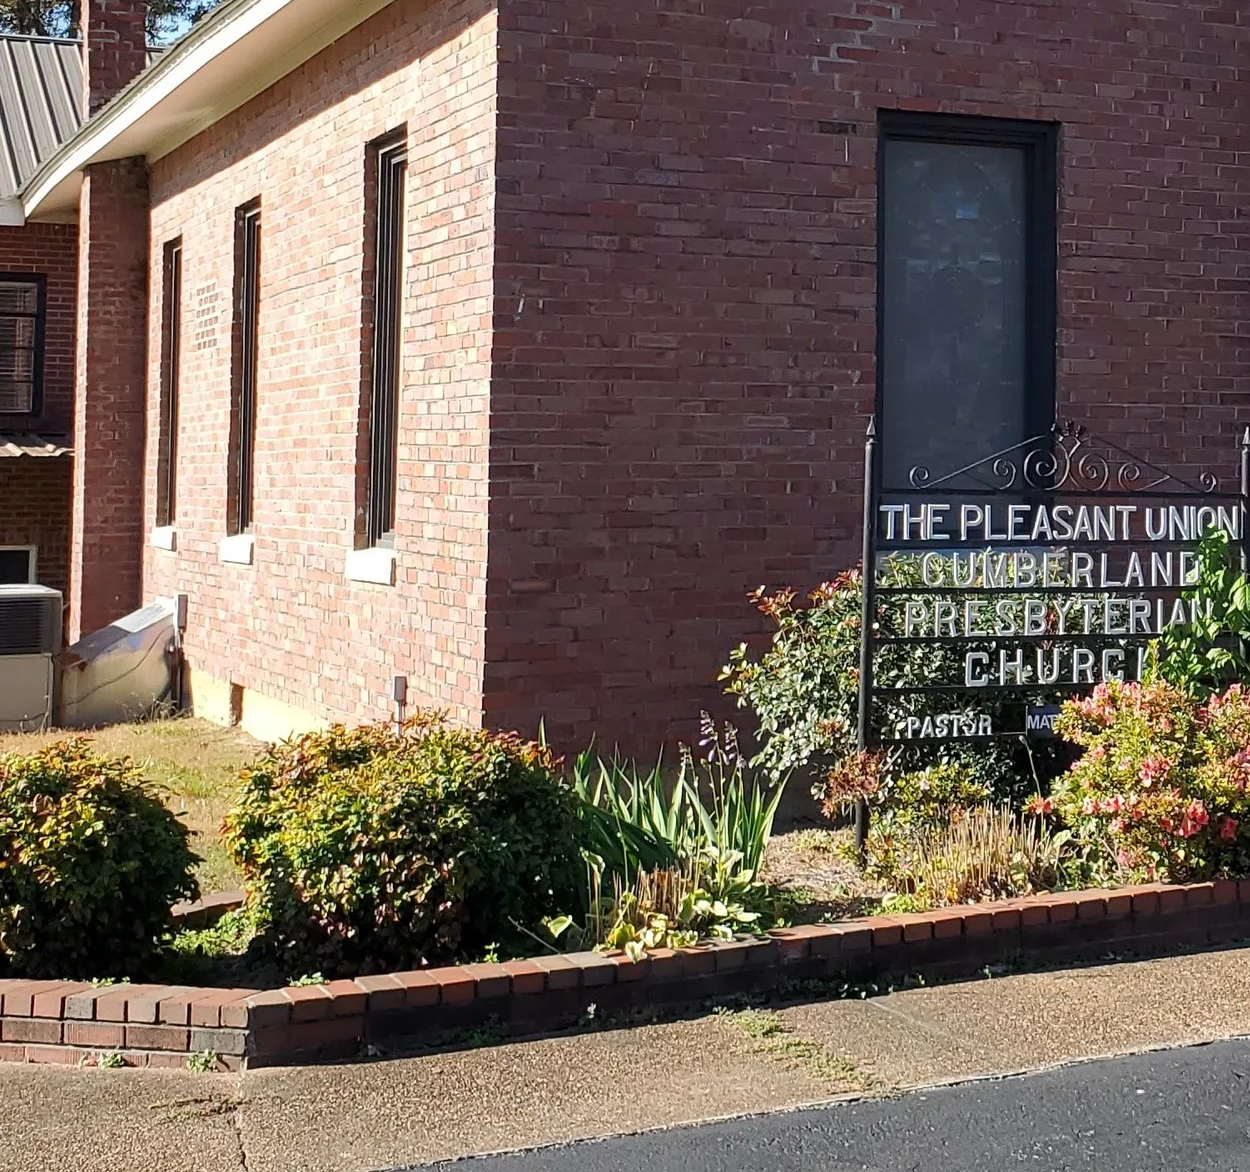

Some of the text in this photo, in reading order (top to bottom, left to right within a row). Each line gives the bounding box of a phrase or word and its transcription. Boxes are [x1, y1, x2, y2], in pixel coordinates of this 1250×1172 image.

[879, 504, 1239, 541] THE PLEASANT UNION
[923, 551, 1200, 588] CUMBERLAND
[905, 598, 1212, 638] PRESBYTERIAN
[965, 647, 1144, 687] CHURC
[907, 713, 1057, 739] PASTOR MAT
